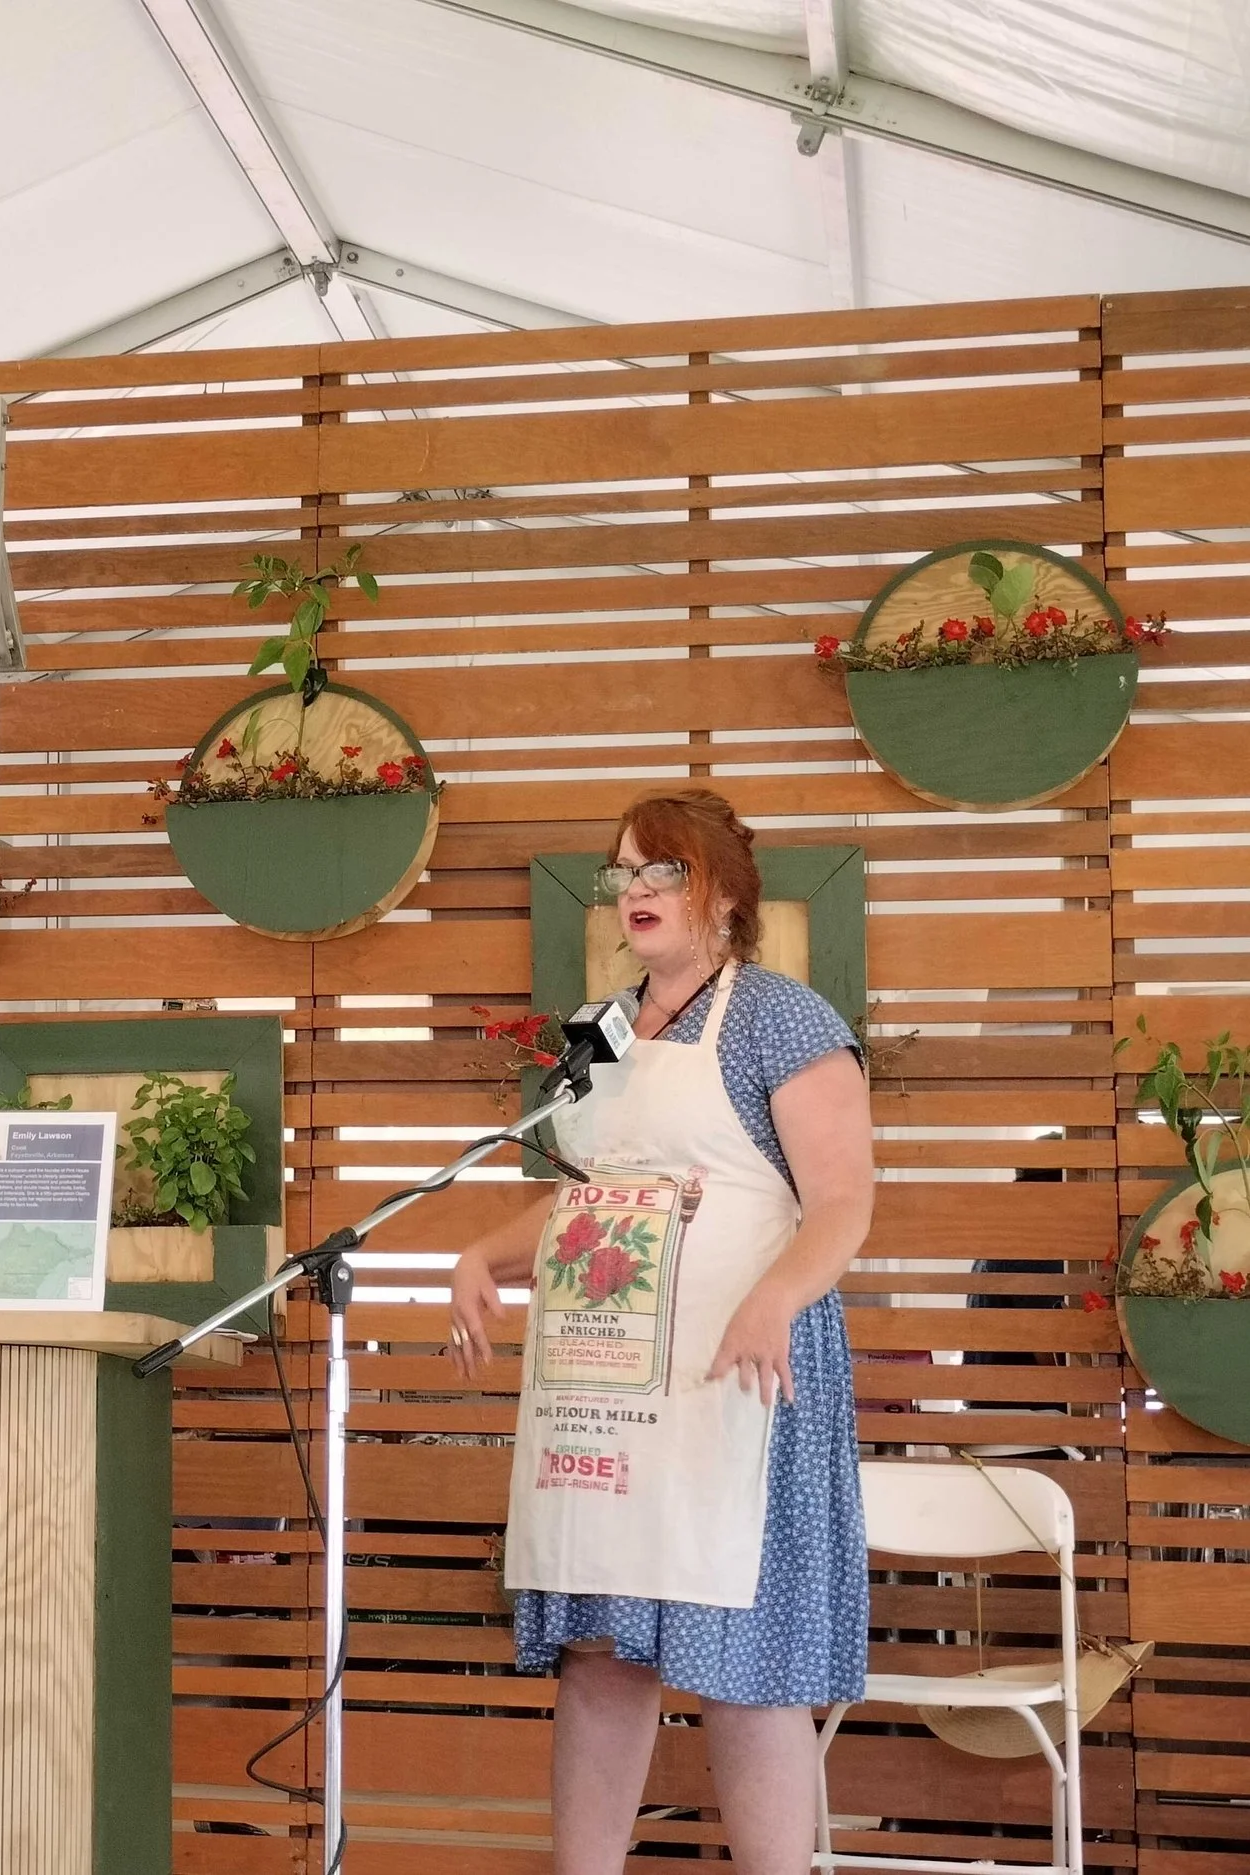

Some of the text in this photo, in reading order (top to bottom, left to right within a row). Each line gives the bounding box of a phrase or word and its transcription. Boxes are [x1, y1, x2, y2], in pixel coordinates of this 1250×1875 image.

[12, 1131, 72, 1141] Emily Lawson
[567, 1186, 659, 1207] ROSE
[563, 1312, 620, 1324] VITAMIN
[560, 1325, 626, 1338] ENRICHED
[559, 1338, 624, 1349] BLEACHED
[547, 1347, 641, 1361] SELF-RISING FLOUR
[613, 1397, 625, 1405] BY
[555, 1406, 602, 1420] FLOUR
[606, 1409, 658, 1424] MILLS
[550, 1453, 615, 1478] ROSE
